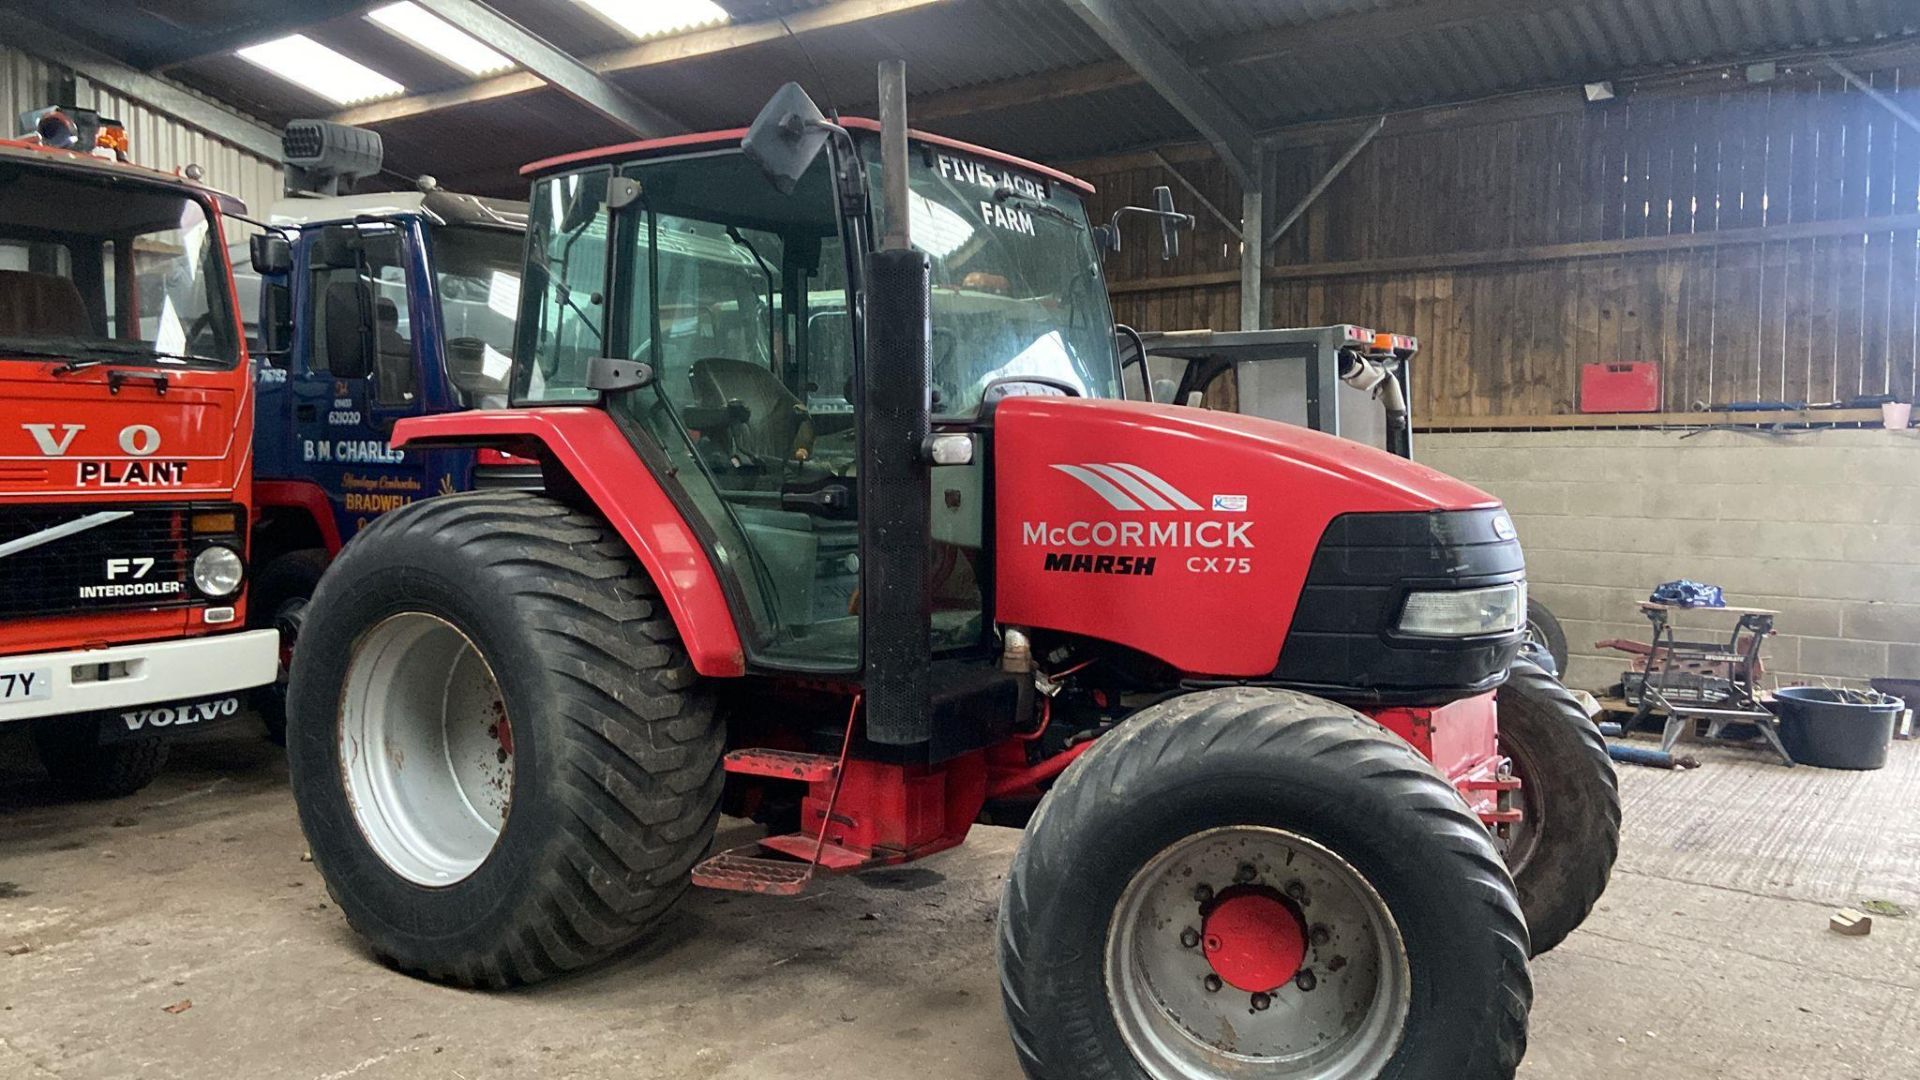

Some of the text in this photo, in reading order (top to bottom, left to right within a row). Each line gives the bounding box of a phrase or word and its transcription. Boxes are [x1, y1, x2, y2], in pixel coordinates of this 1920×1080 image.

[938, 153, 1046, 201] FIVE ACRE
[980, 200, 1035, 236] FARM
[328, 411, 361, 425] 621020
[336, 440, 405, 463] CHARLES
[77, 461, 188, 487] PLANT
[1022, 521, 1255, 548] McCORMICK
[107, 558, 155, 580] F7
[1044, 553, 1156, 576] MARSH
[1186, 557, 1251, 574] CX 75
[79, 582, 180, 598] INTERCOOLER
[0, 671, 35, 697] 7Y
[121, 698, 238, 730] VOLVO
